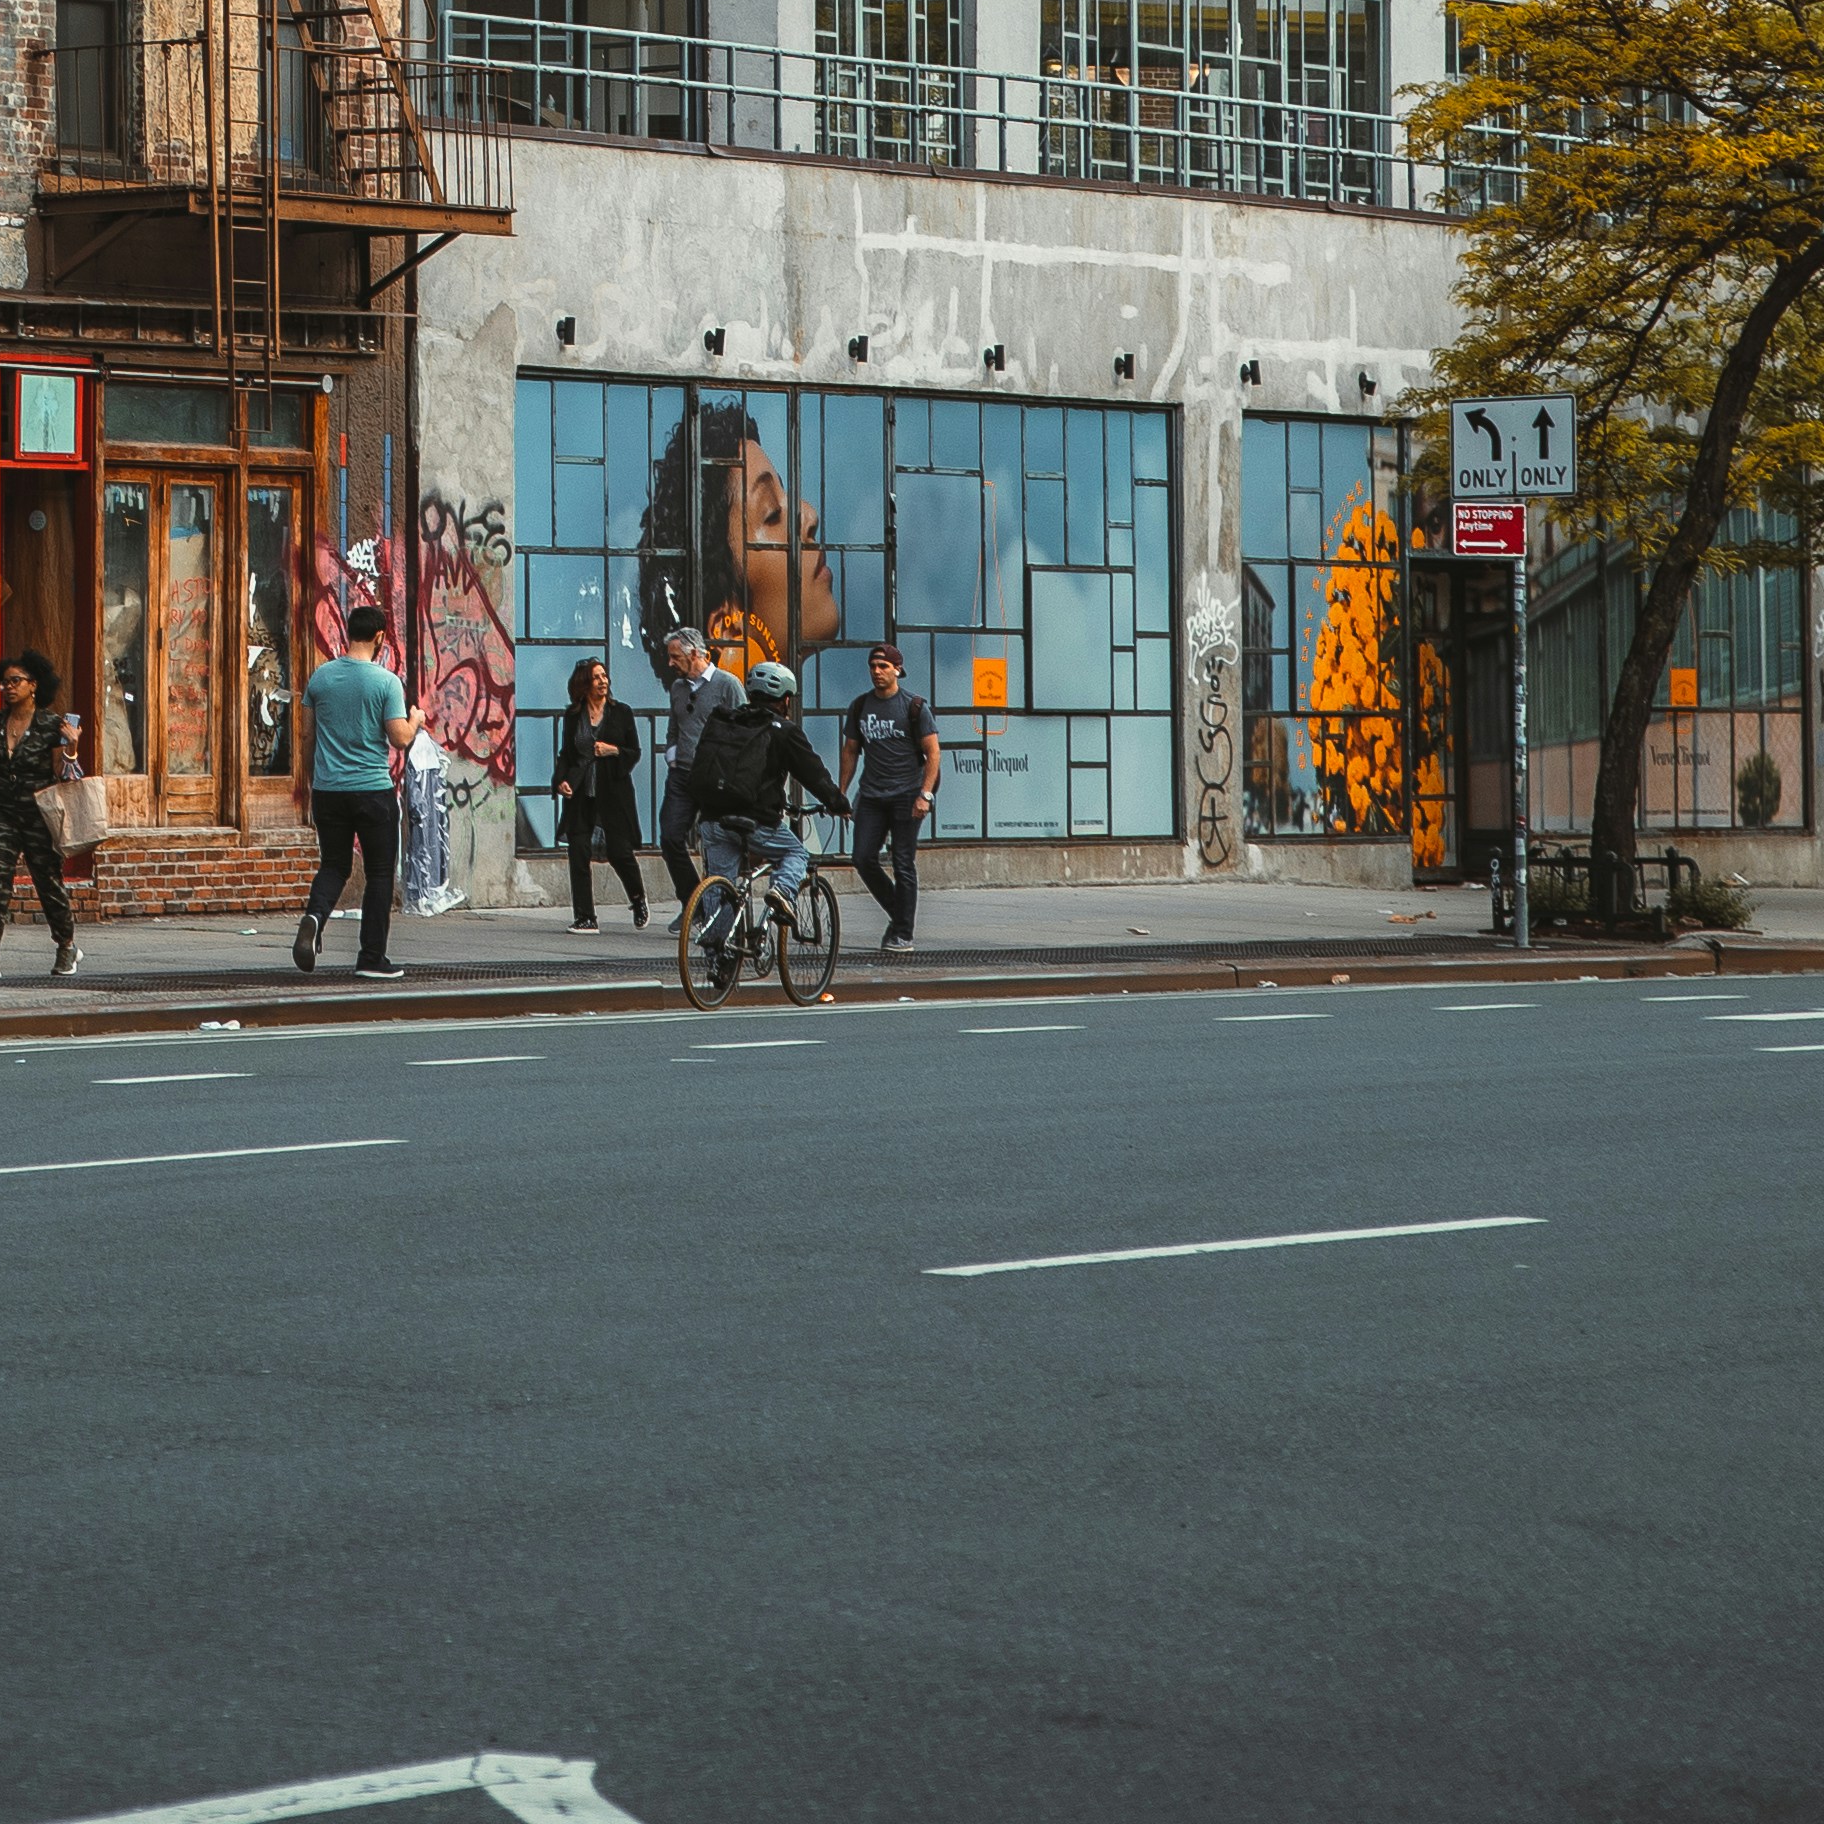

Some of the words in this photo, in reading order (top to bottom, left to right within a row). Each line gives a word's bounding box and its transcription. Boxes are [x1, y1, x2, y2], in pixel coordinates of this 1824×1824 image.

[1459, 468, 1507, 489] ONLY
[1521, 466, 1567, 486] ONLY
[1457, 510, 1470, 520] NO
[1472, 509, 1514, 520] STOPPING
[1458, 520, 1494, 533] Anytime
[724, 610, 745, 629] DAY
[951, 750, 983, 774] Veuve
